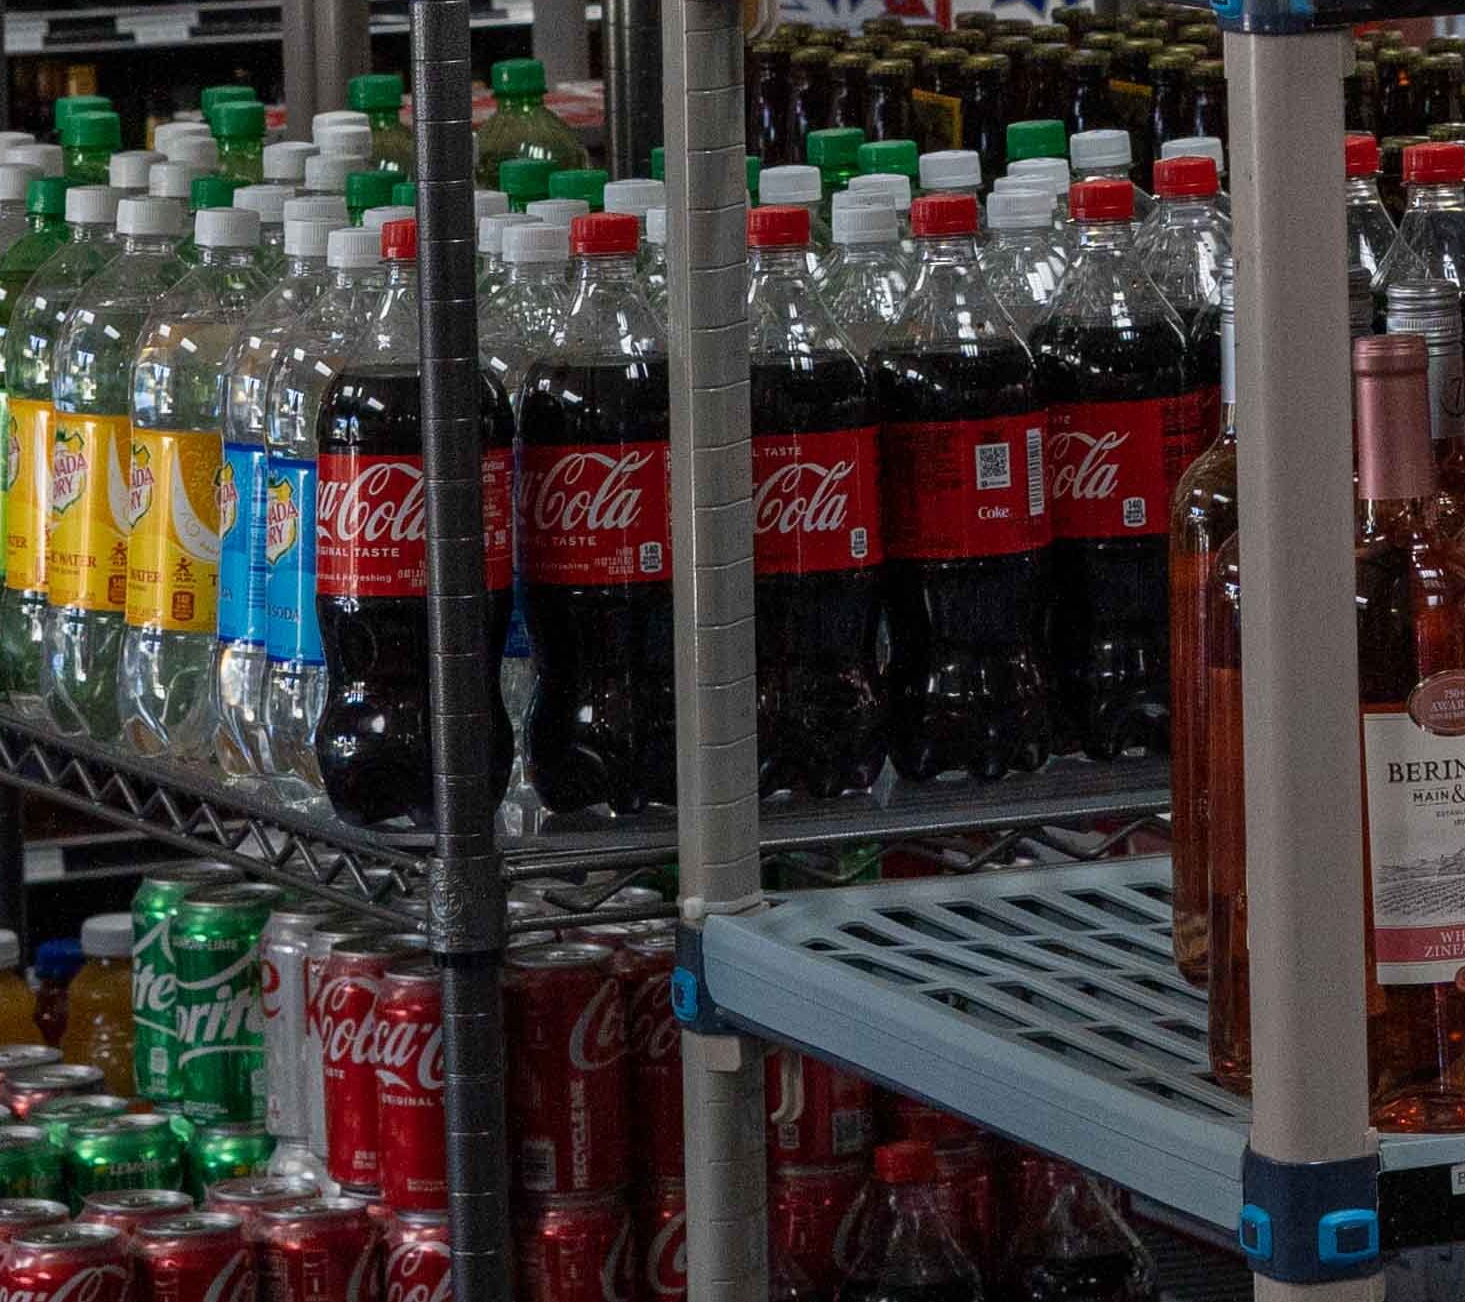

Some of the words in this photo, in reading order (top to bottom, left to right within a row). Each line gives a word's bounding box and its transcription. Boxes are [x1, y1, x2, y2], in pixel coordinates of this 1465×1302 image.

[978, 505, 1010, 520] Coke
[350, 547, 401, 559] TASTE
[1413, 789, 1449, 804] MAIN
